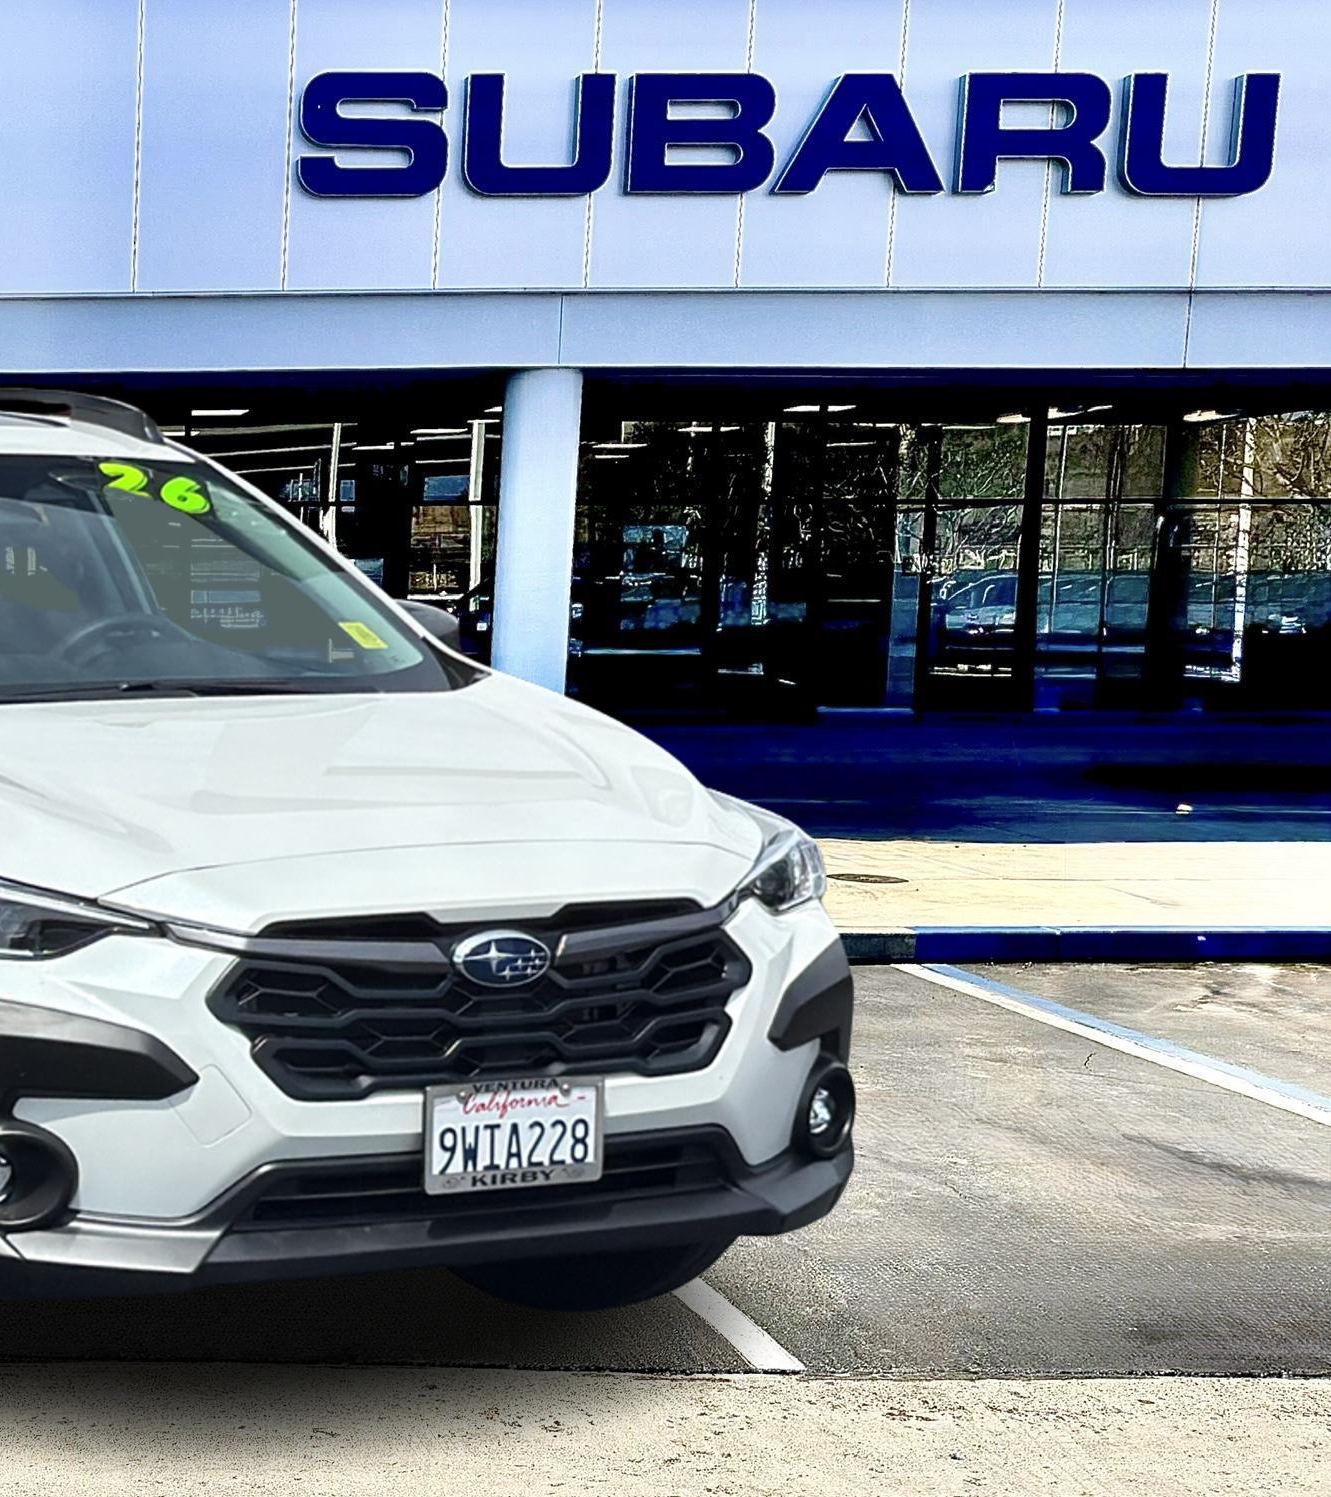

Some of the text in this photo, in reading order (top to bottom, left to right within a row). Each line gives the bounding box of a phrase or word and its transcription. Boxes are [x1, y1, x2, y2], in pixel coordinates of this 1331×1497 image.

[297, 72, 1281, 198] SUBARU
[98, 461, 211, 514] 26
[462, 1091, 569, 1119] California
[472, 1078, 559, 1094] VENTURA
[439, 1117, 589, 1175] 9WIA228
[471, 1168, 555, 1188] KIRBY
